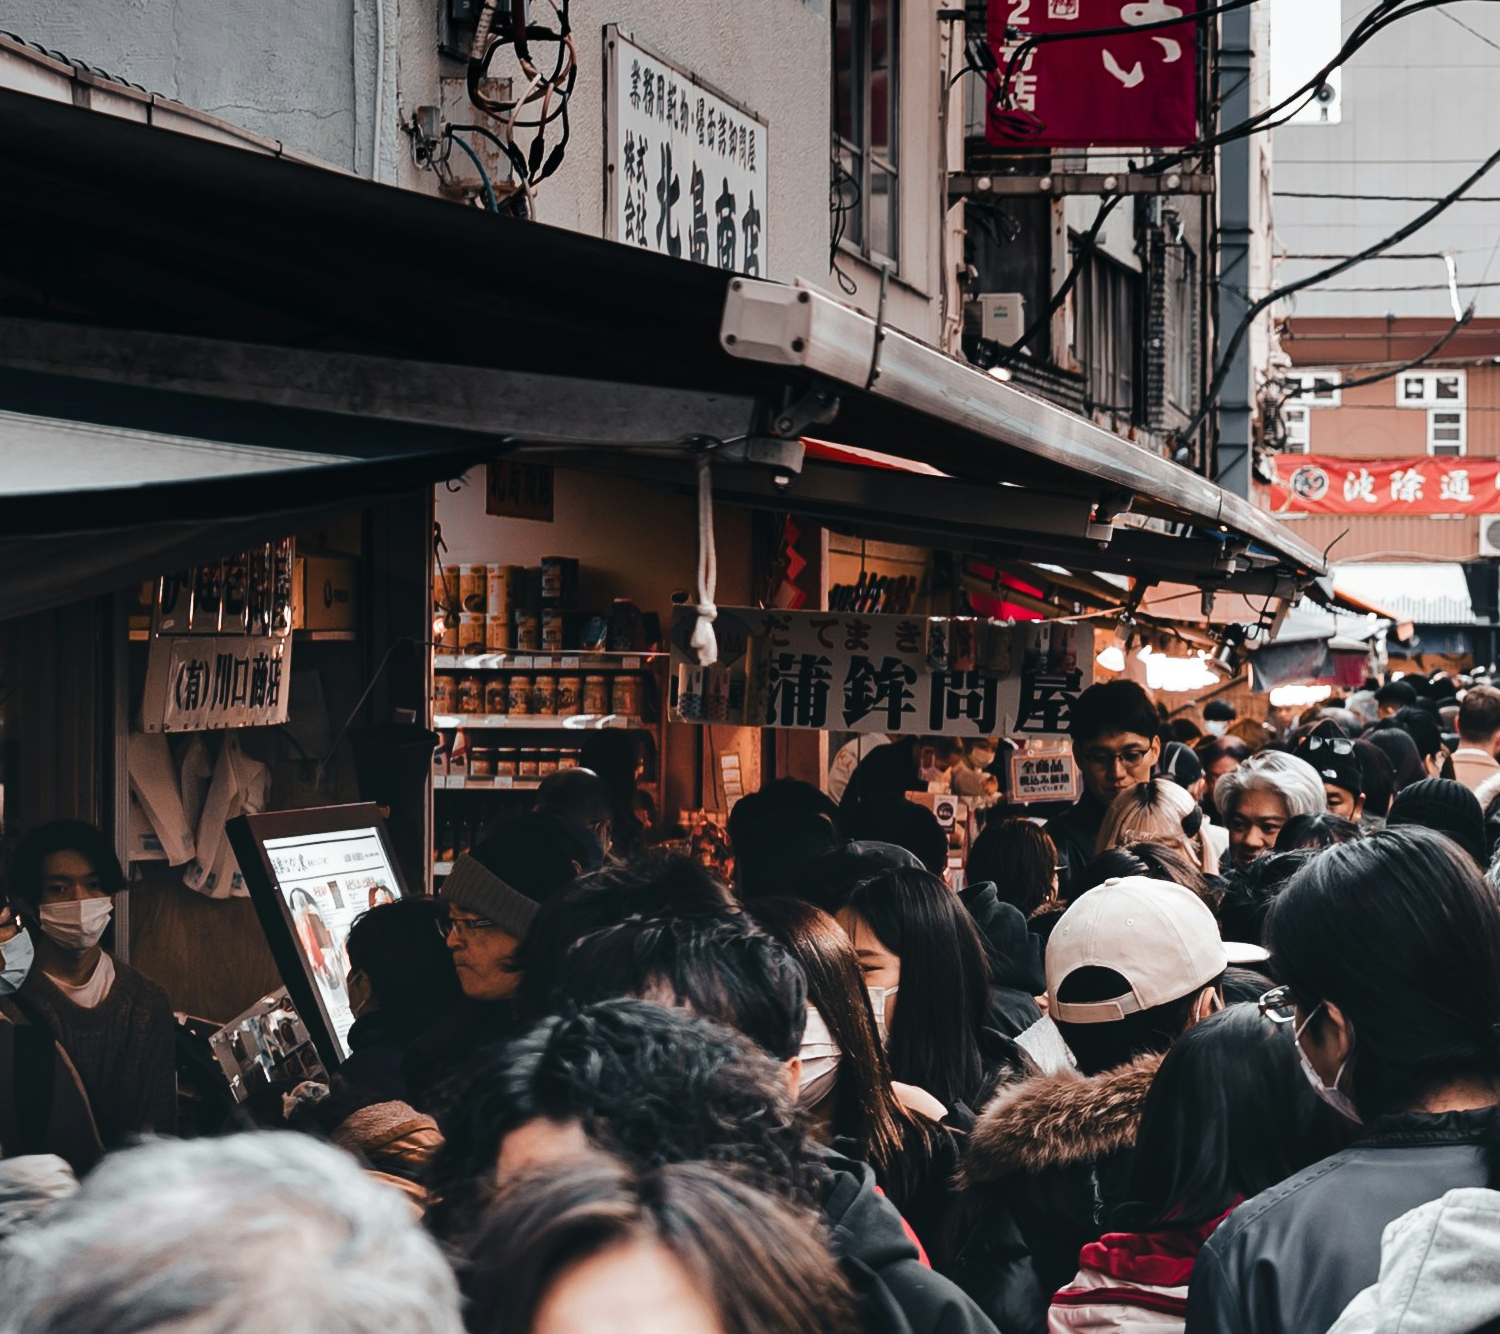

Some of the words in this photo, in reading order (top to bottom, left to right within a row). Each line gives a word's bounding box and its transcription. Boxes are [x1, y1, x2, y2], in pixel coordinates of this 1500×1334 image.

[761, 614, 923, 654] だてまき
[765, 652, 1085, 736] 蒲鉾問屋
